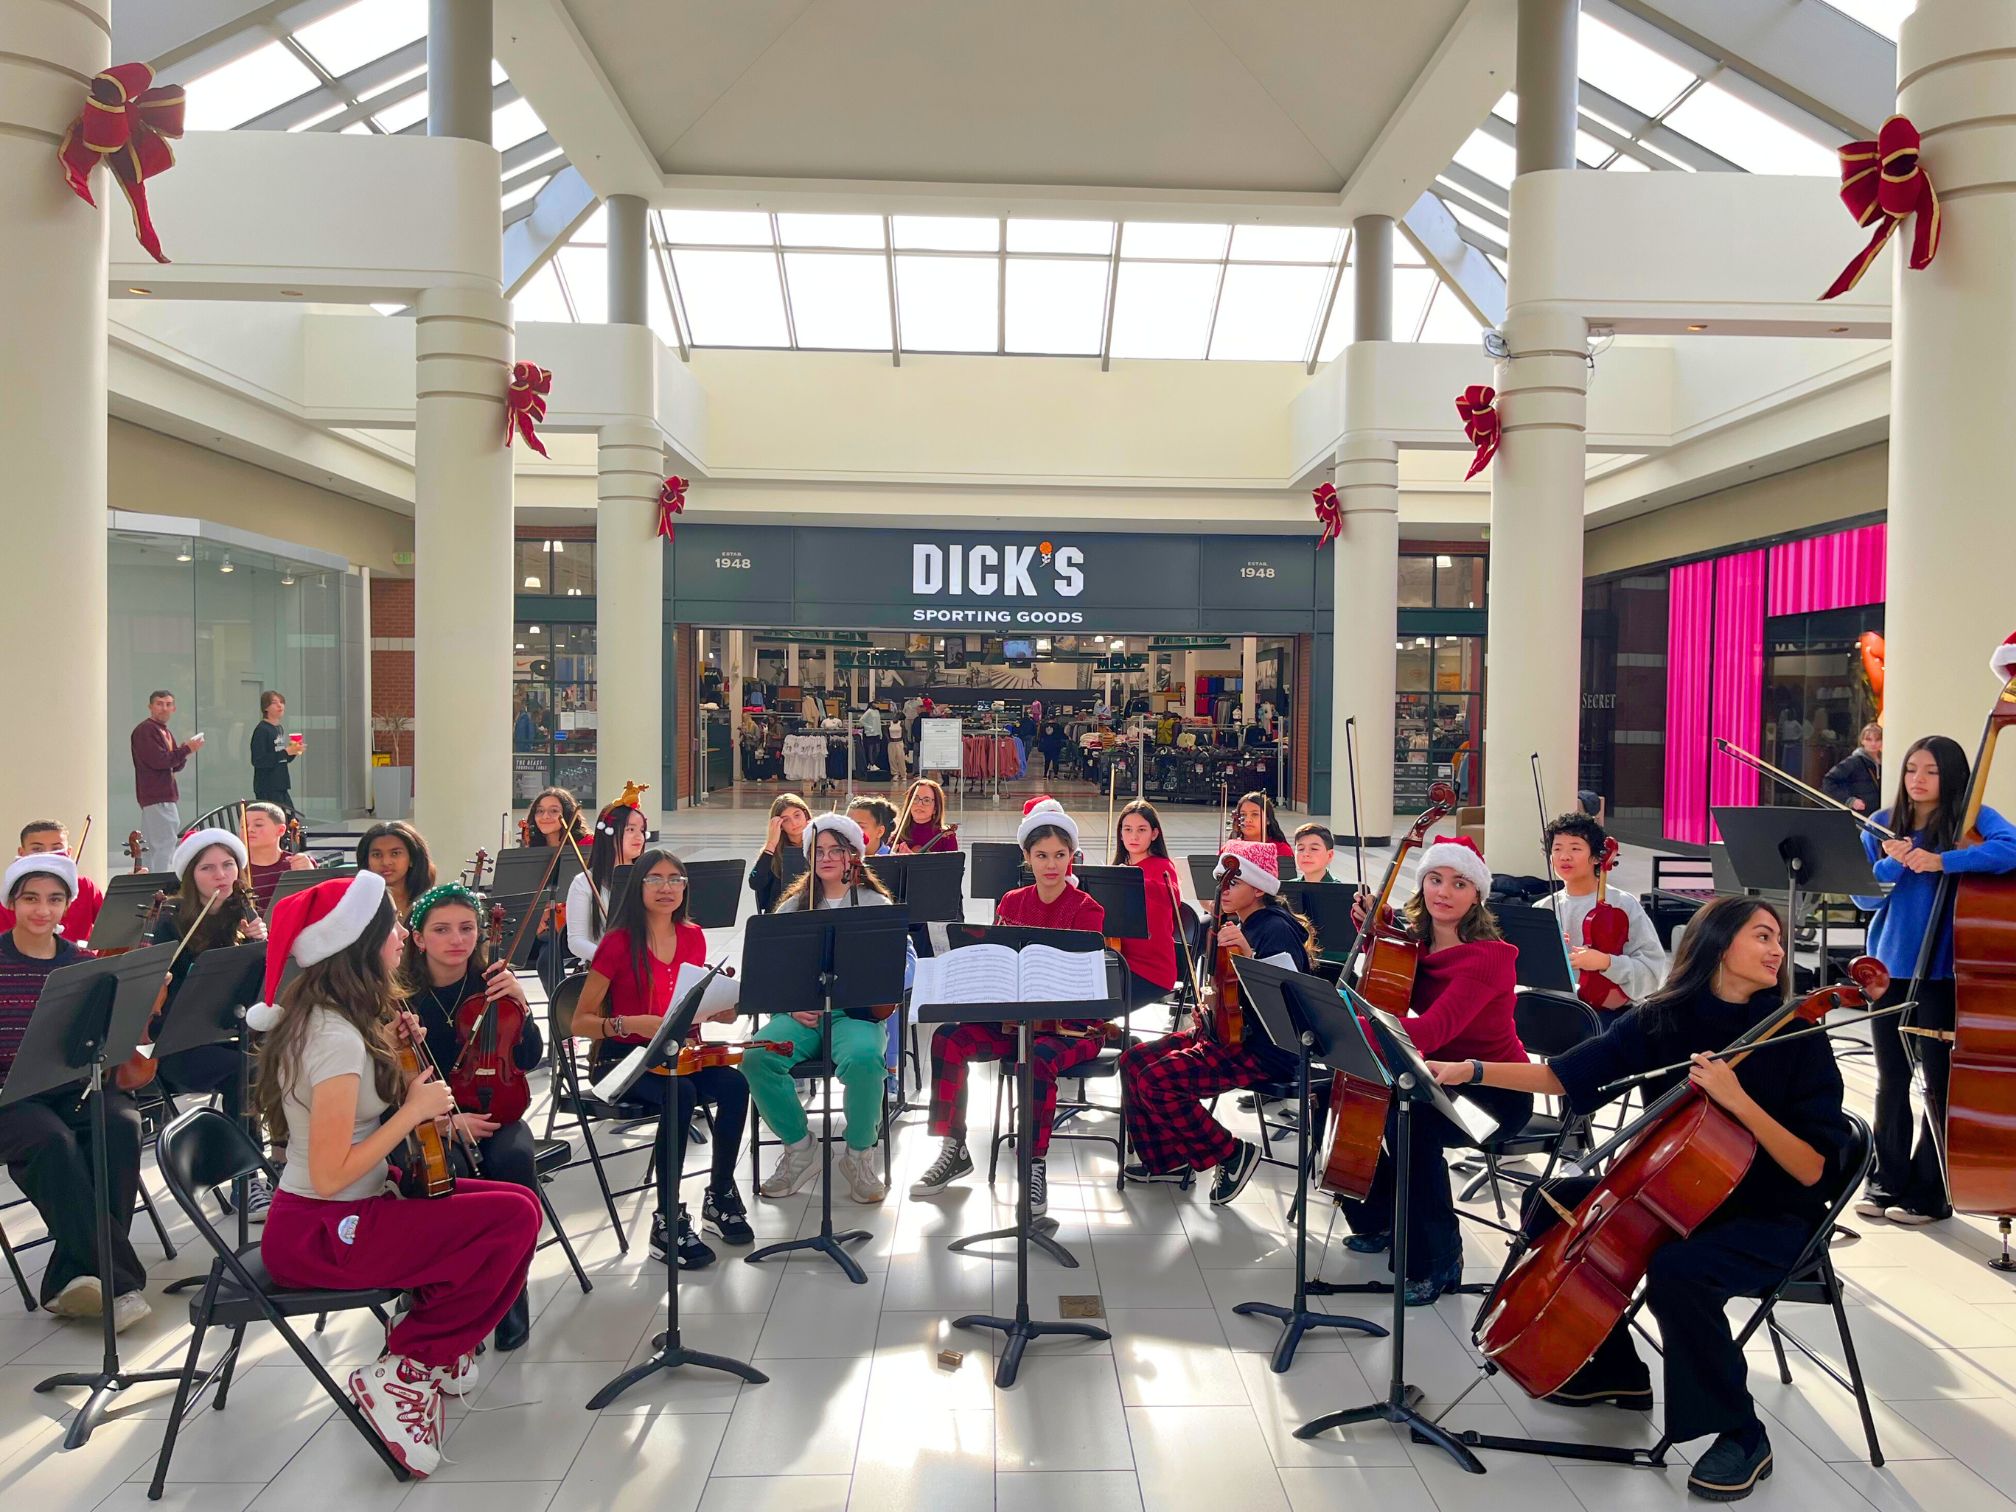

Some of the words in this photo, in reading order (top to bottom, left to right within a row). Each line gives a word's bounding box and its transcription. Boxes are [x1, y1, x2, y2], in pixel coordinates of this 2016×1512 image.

[715, 558, 751, 569] 1948
[913, 542, 1084, 597] DICK'S
[1240, 567, 1275, 578] 1948
[913, 609, 1011, 622] SPORTING
[1017, 611, 1083, 624] GOODS
